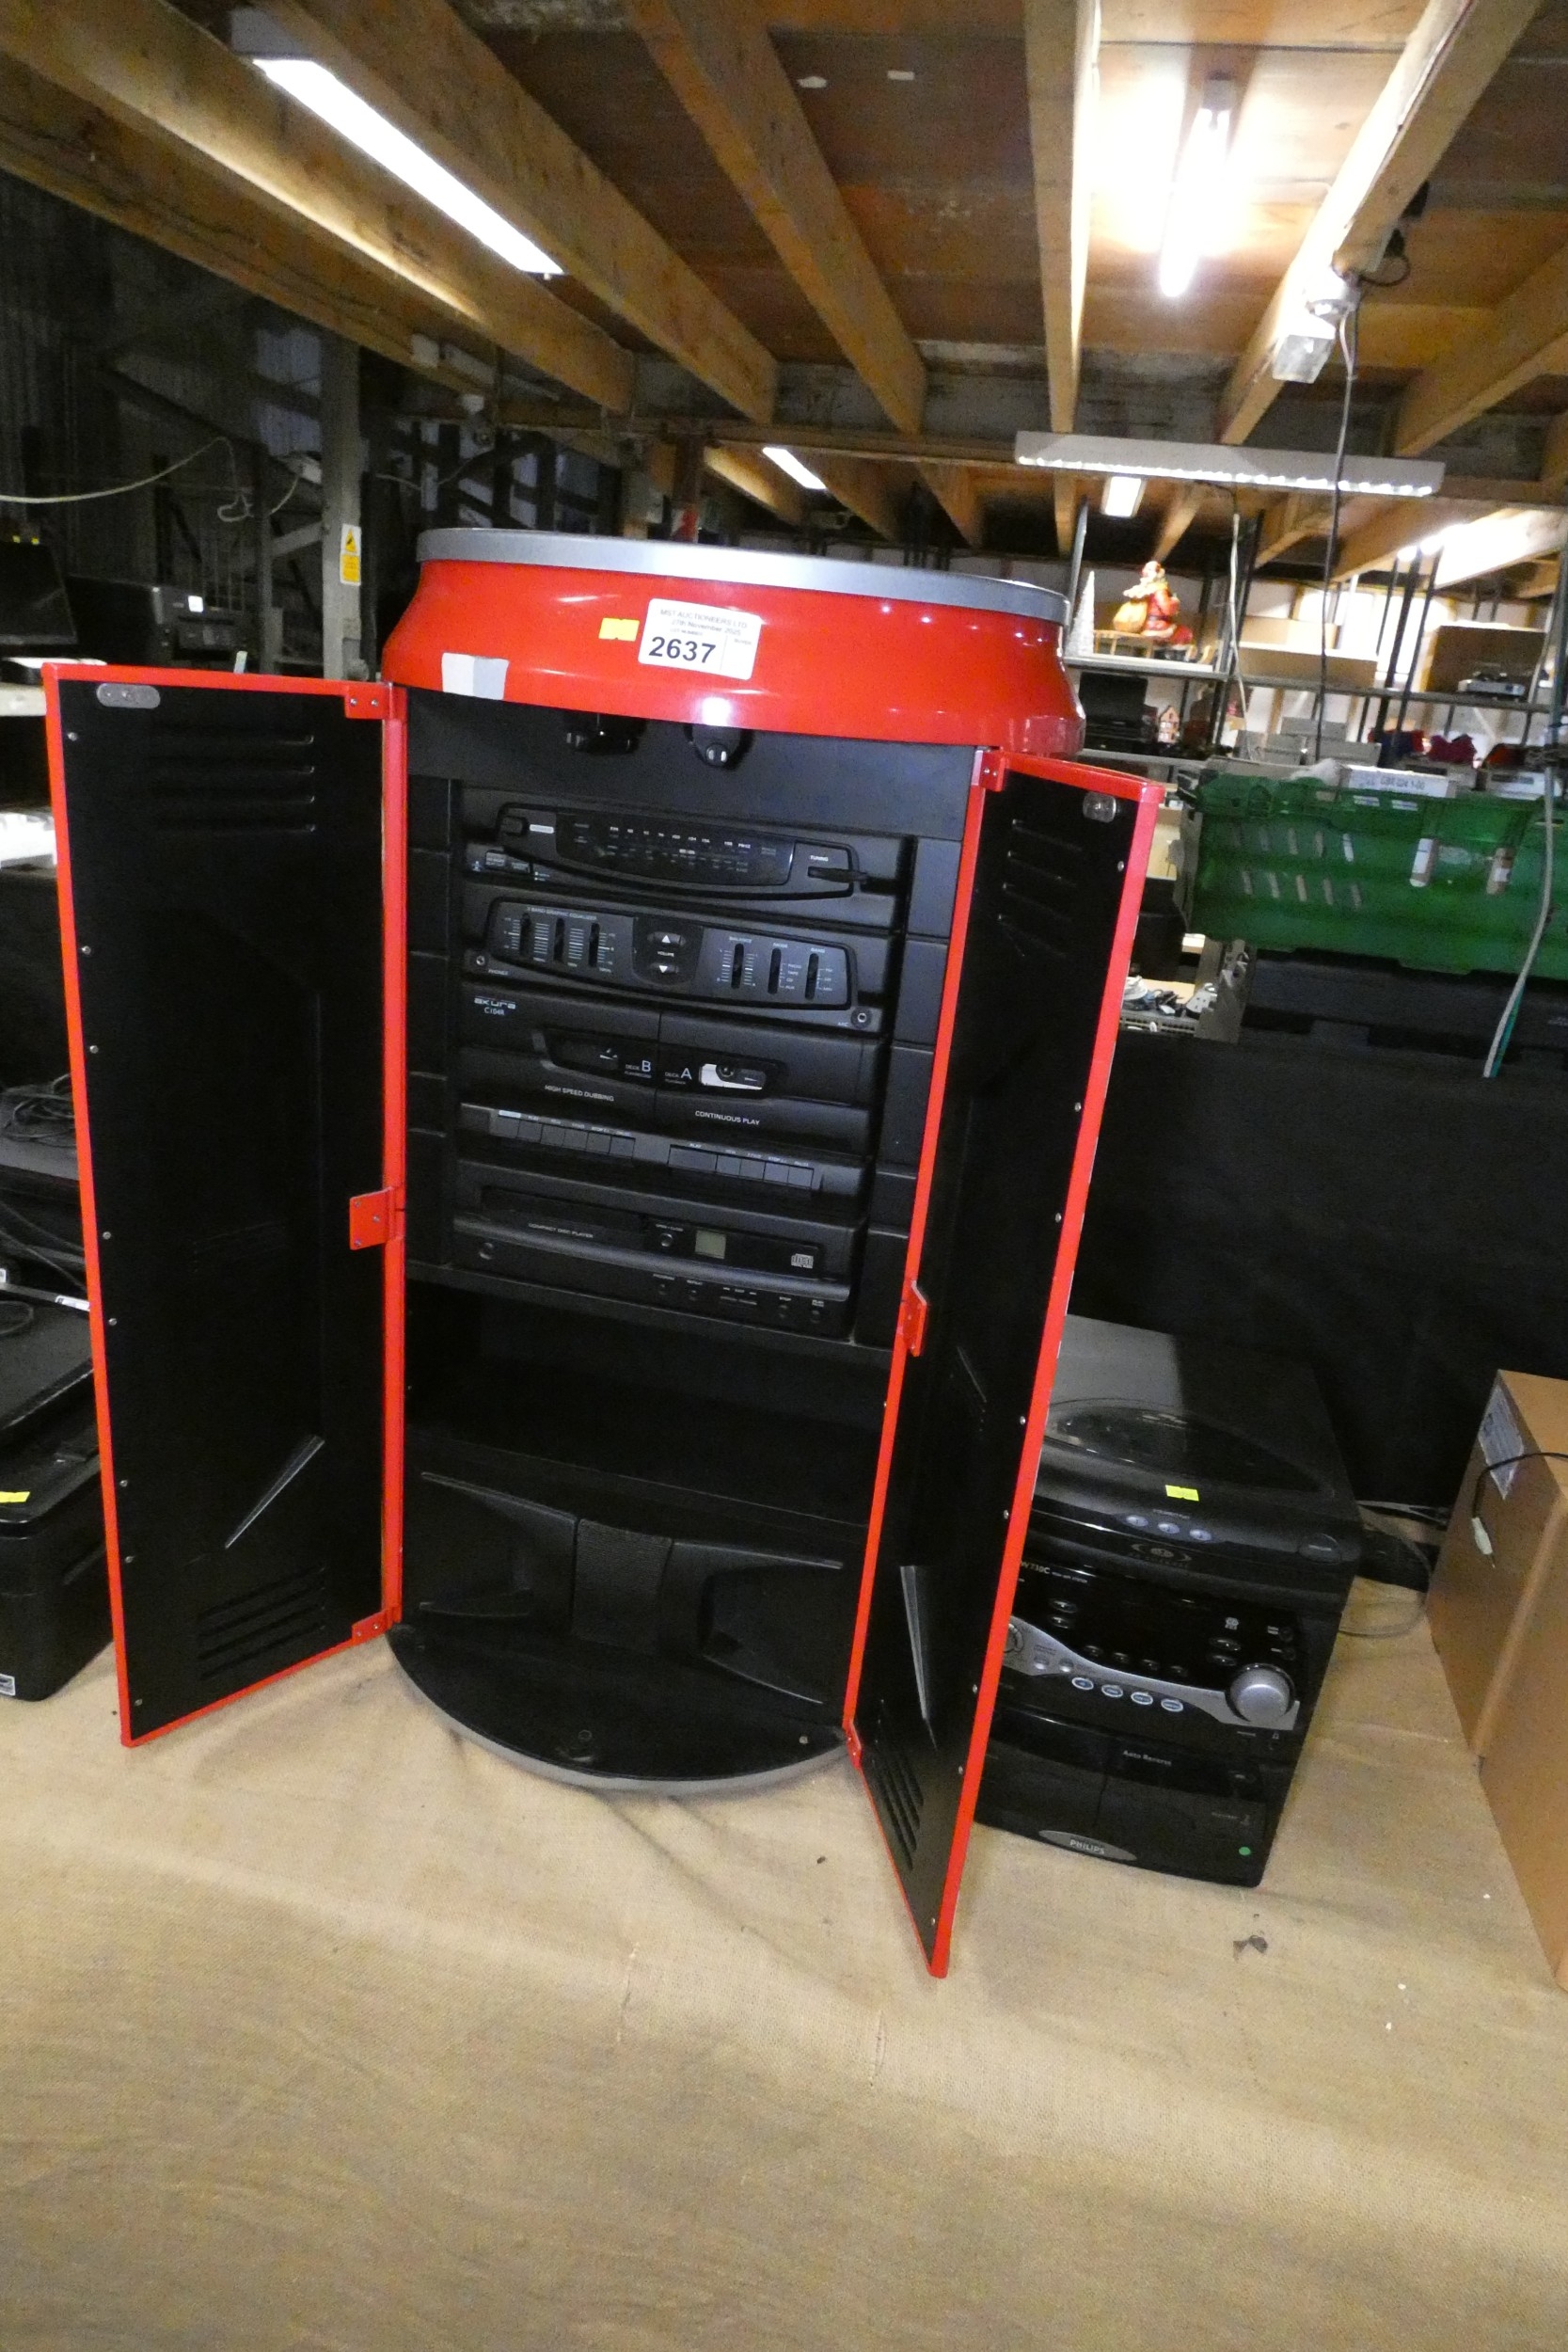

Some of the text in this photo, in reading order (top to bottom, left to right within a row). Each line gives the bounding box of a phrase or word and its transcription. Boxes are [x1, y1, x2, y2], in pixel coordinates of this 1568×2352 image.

[660, 609, 748, 629] MST AUCTIONEERS LTD
[688, 621, 722, 632] November
[724, 627, 741, 636] 2025
[649, 636, 717, 663] 2637
[641, 1059, 652, 1073] B
[680, 1067, 692, 1081] A
[545, 1084, 615, 1103] HIGH SPEED DUBBING
[695, 1110, 760, 1126] CONTINUOUS PLAY
[528, 1222, 557, 1232] COMPACT
[571, 1231, 594, 1239] PLAYER
[1123, 1749, 1142, 1759] Auto
[1069, 1838, 1106, 1855] PHILIPS
